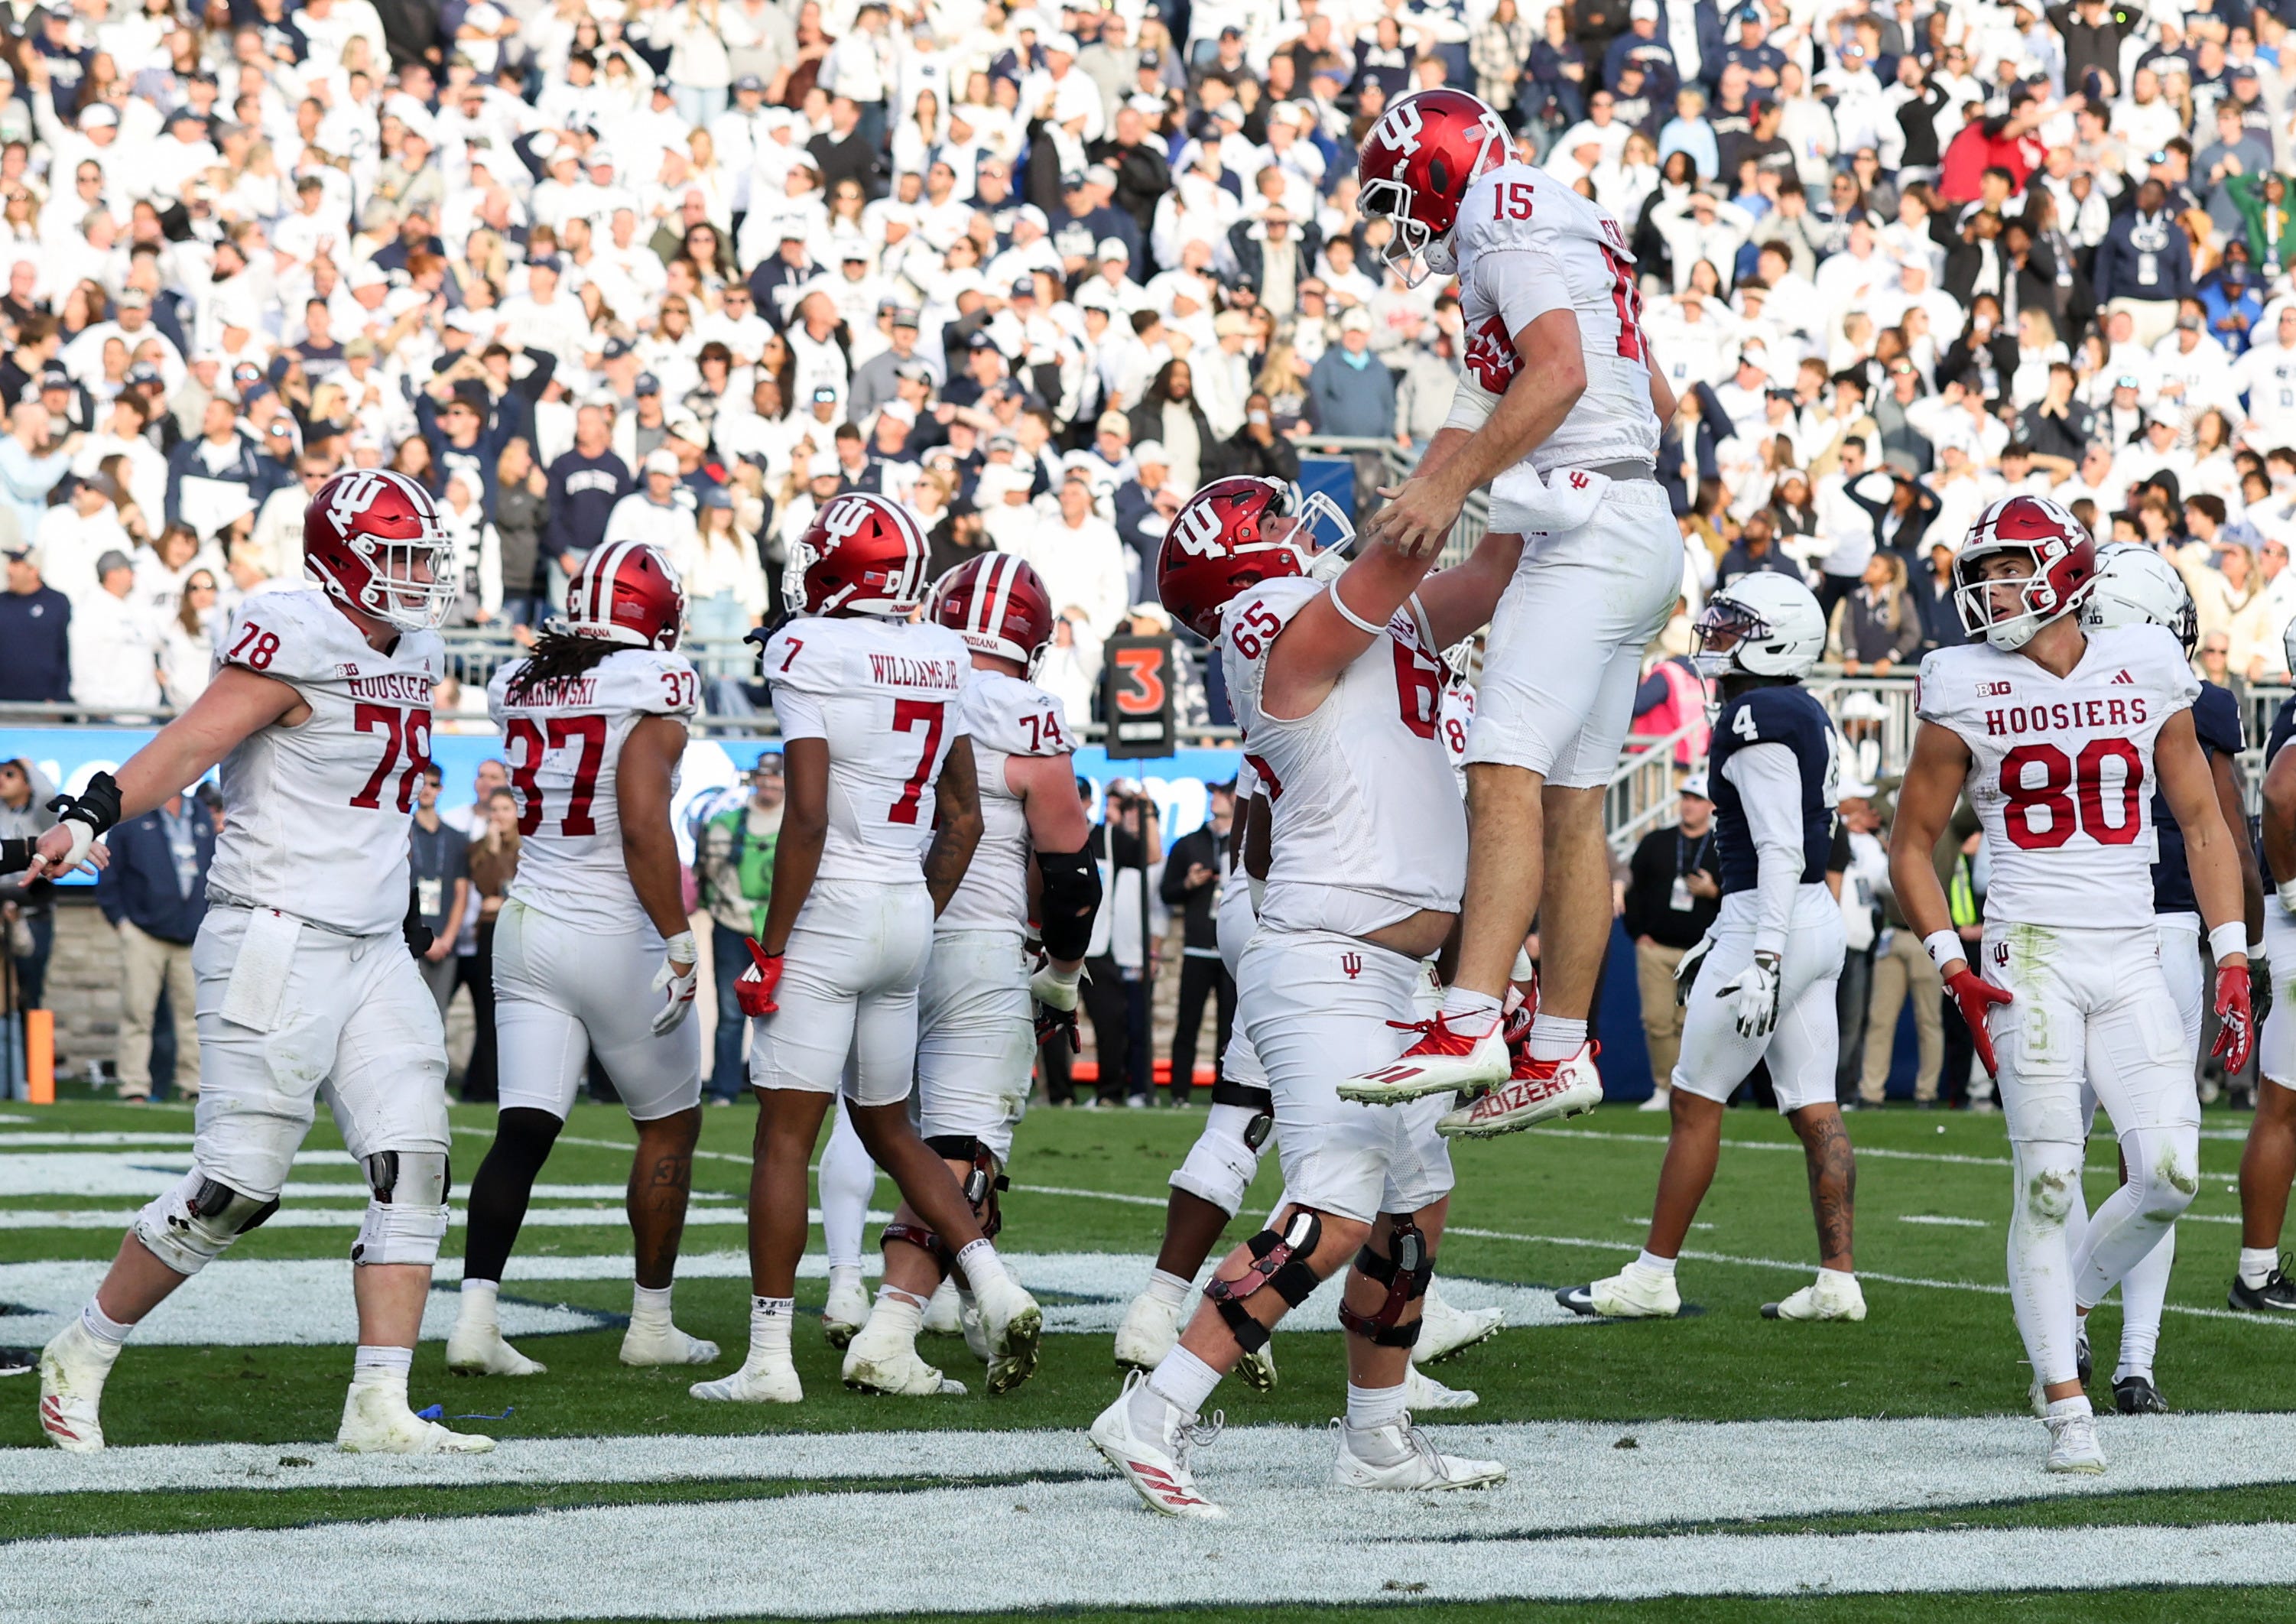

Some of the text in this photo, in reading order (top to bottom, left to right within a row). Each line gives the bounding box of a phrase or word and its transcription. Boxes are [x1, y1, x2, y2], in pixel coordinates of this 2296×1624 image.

[1493, 182, 1534, 222] 15
[229, 620, 281, 671] 78
[1232, 599, 1281, 661] 65
[780, 636, 804, 674] 7
[869, 654, 943, 689] WILLIAMS
[660, 671, 695, 708] 37
[1116, 648, 1166, 714] 3
[1018, 710, 1064, 752] 74
[1731, 703, 1759, 742] 4
[1985, 697, 2148, 736] HOOSIERS
[349, 702, 433, 815] 78
[505, 714, 607, 837] 37
[887, 698, 945, 825] 7
[1999, 737, 2145, 850] 80
